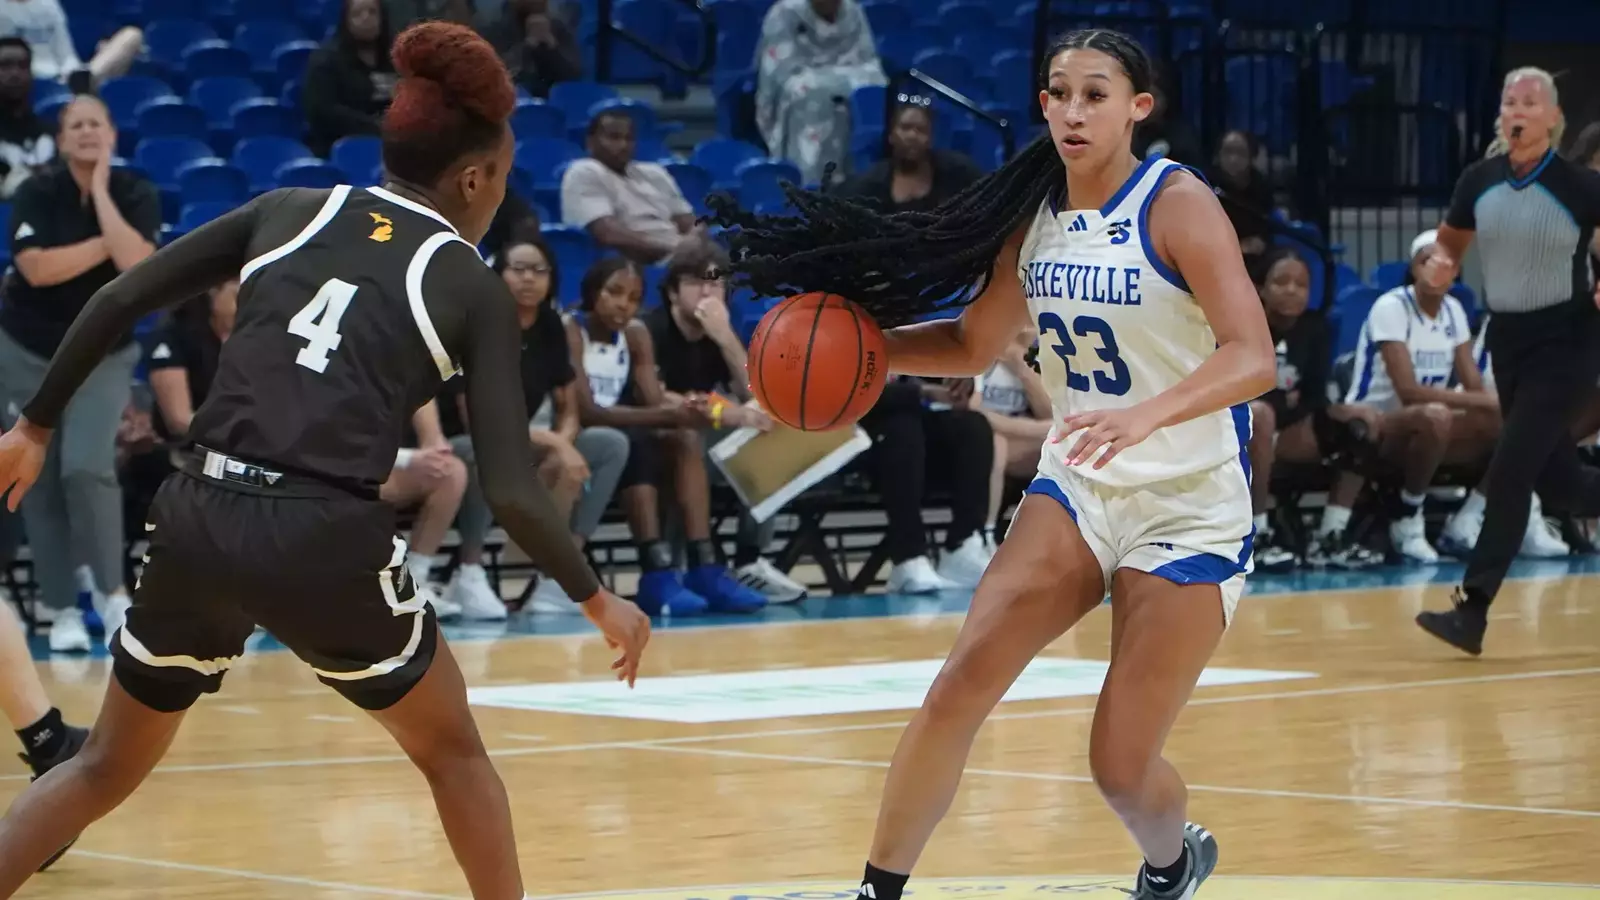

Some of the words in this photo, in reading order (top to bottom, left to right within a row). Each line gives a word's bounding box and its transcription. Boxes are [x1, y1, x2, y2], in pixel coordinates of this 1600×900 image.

[287, 277, 359, 374] 4
[1023, 262, 1142, 306] SHEVILLE
[1038, 312, 1132, 396] 23
